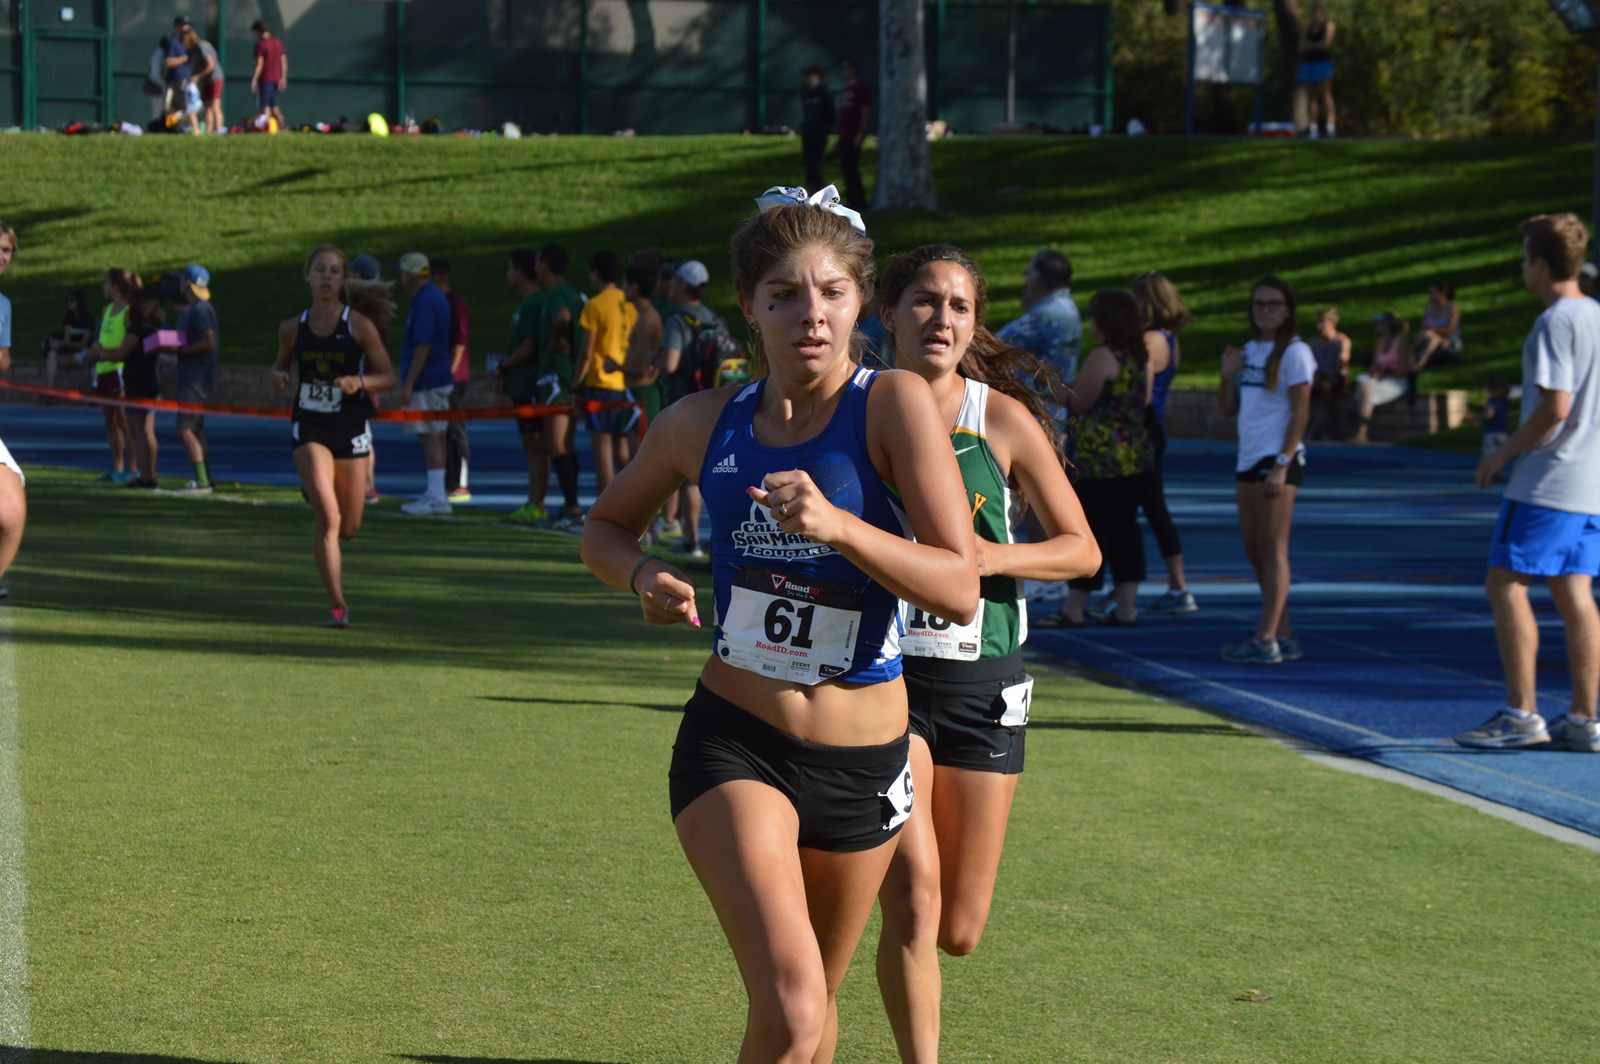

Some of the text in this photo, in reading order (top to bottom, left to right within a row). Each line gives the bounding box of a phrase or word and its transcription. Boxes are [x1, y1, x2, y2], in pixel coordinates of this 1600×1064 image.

[308, 384, 333, 402] 124
[712, 464, 738, 473] adidas
[970, 492, 987, 520] Y
[743, 522, 774, 533] CAL
[733, 532, 816, 547] SAN MAR
[752, 545, 831, 557] COUGARS
[764, 598, 815, 649] 61
[908, 629, 950, 638] RoadID.com
[755, 641, 808, 658] RoadID.com
[792, 661, 811, 669] EVENT
